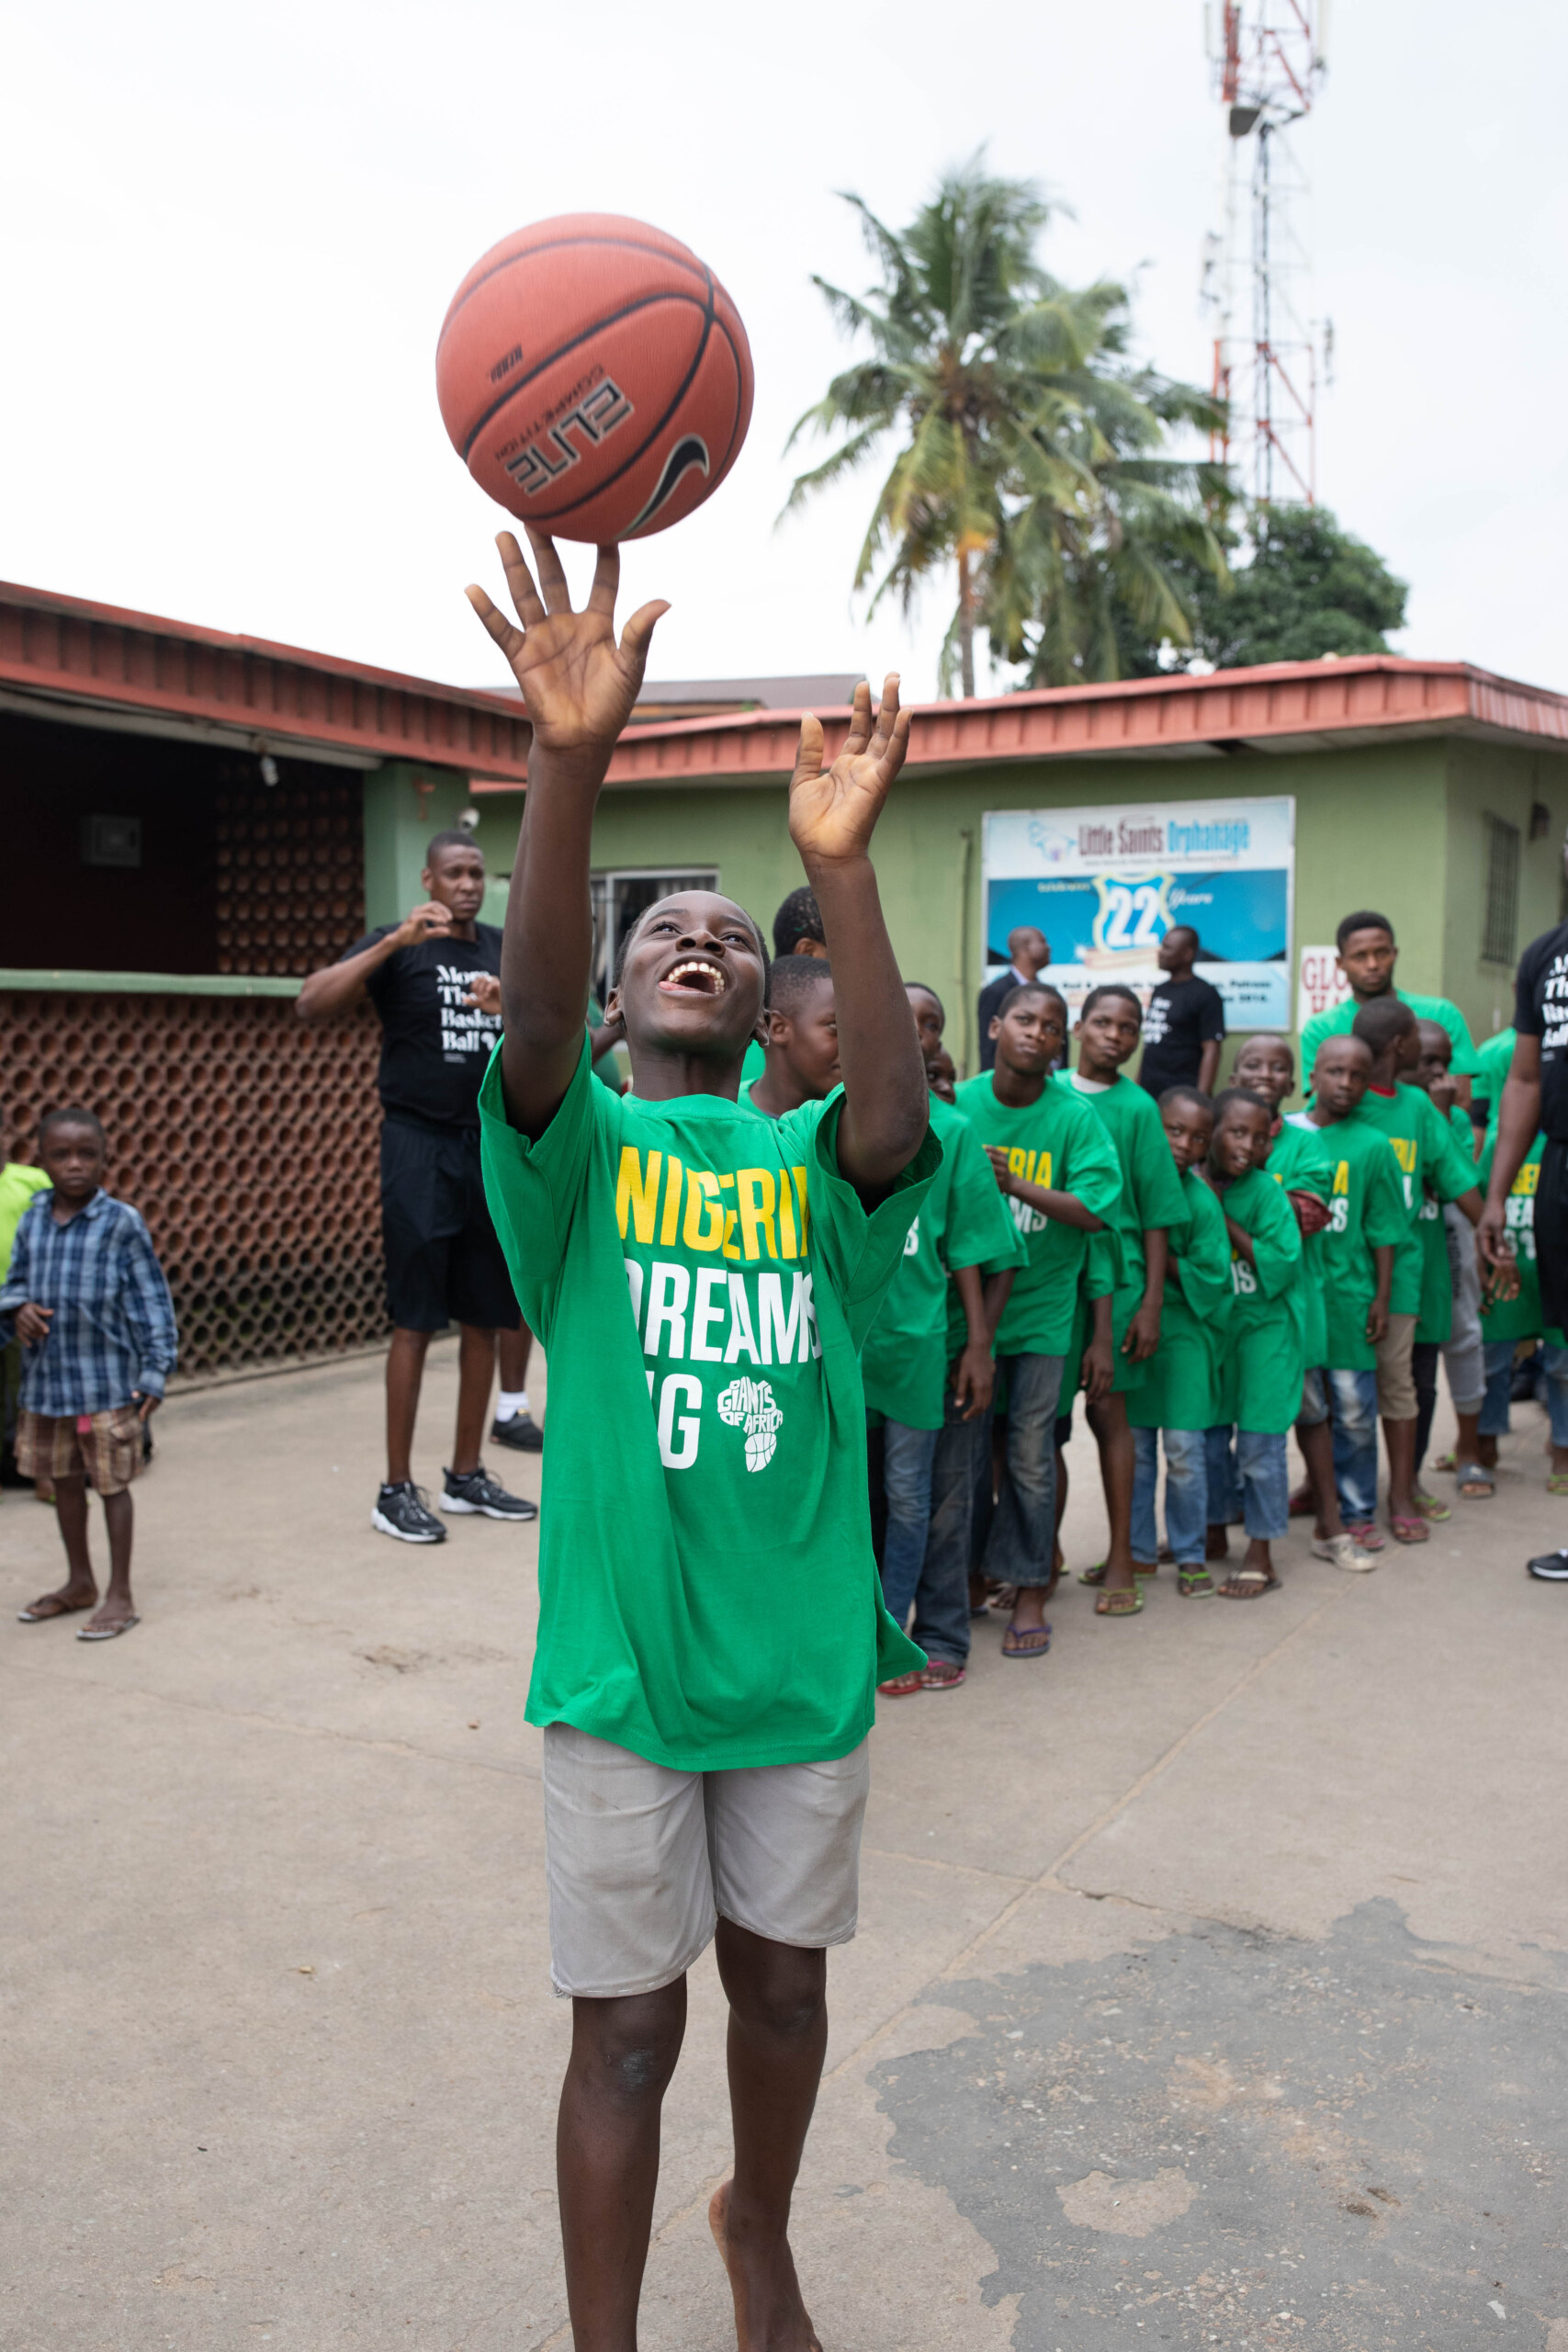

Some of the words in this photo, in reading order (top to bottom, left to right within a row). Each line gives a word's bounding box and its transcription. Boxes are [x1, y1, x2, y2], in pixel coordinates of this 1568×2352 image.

[505, 377, 635, 497] ELITE
[1078, 824, 1113, 855] Little
[1118, 820, 1164, 854] Saints
[1167, 820, 1250, 854] Orphanage
[1107, 885, 1160, 947] 22
[441, 1008, 503, 1030] Basket
[442, 1030, 479, 1052] Ball
[717, 1376, 776, 1415] GIANTS
[720, 1411, 746, 1427] OF
[743, 1408, 784, 1437] AFRICA
